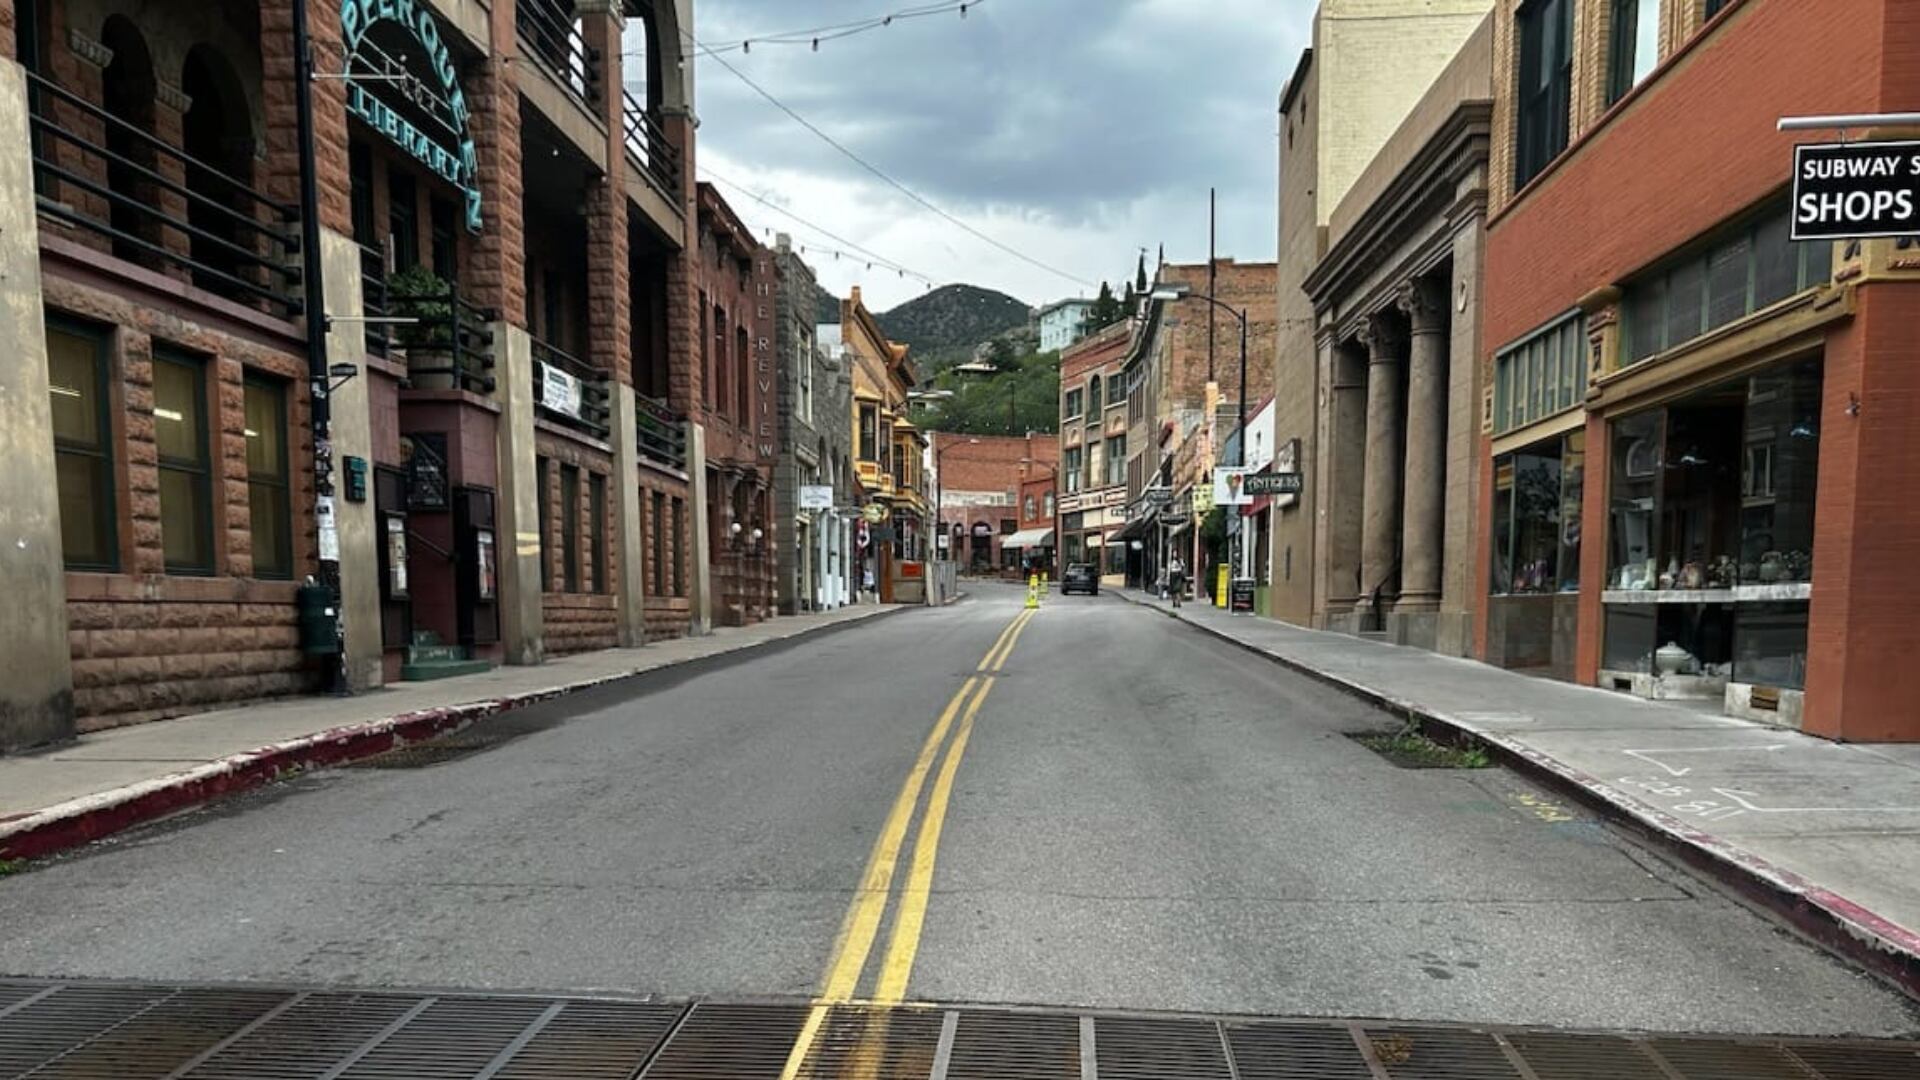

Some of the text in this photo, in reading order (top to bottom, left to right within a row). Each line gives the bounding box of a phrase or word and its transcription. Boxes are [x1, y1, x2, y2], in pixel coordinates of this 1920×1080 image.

[354, 84, 461, 183] LIBRARY
[1803, 156, 1901, 180] SUBWAY
[1798, 189, 1913, 223] SHOPS
[757, 262, 772, 457] THE REVIEW
